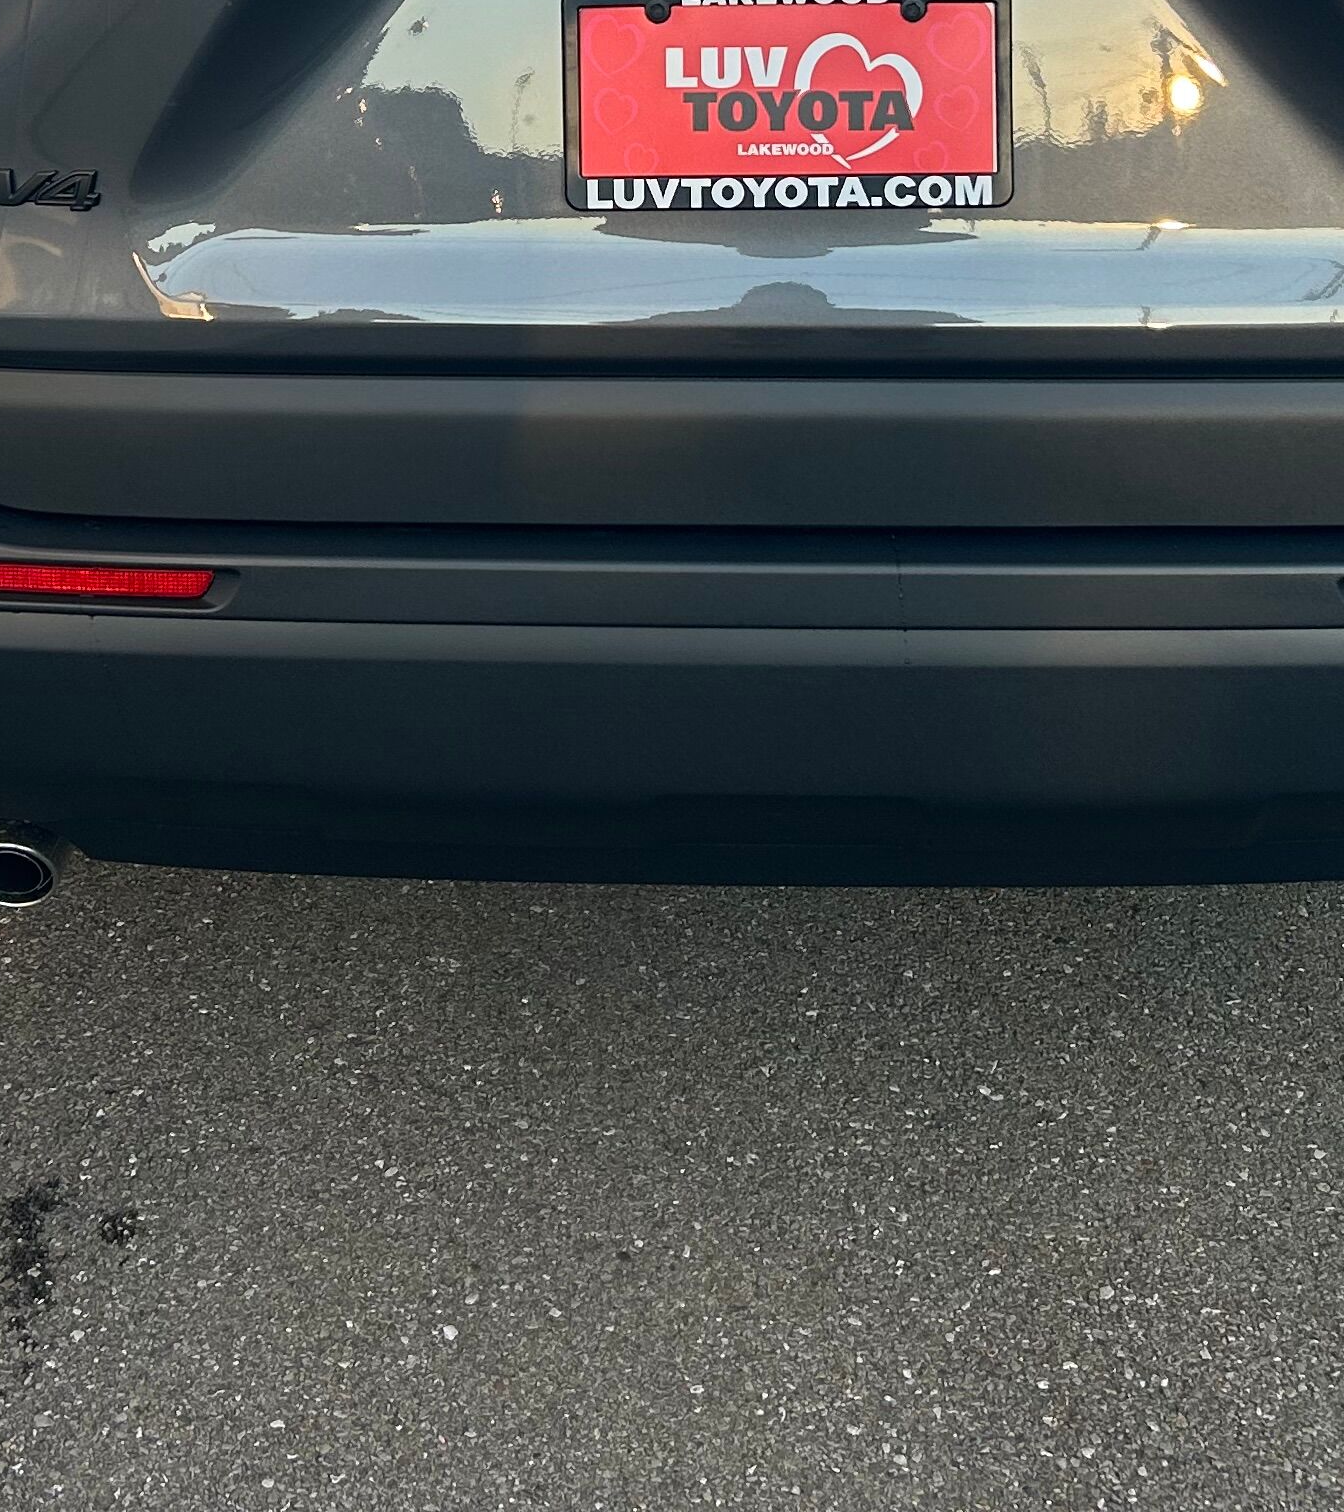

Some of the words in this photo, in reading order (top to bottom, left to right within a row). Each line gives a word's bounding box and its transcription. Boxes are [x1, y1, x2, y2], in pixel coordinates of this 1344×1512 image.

[665, 46, 788, 88] LUV
[682, 89, 915, 132] TOYOTA
[737, 142, 834, 156] LAKEWOOD
[587, 175, 992, 209] LUVTOYOTA.COM
